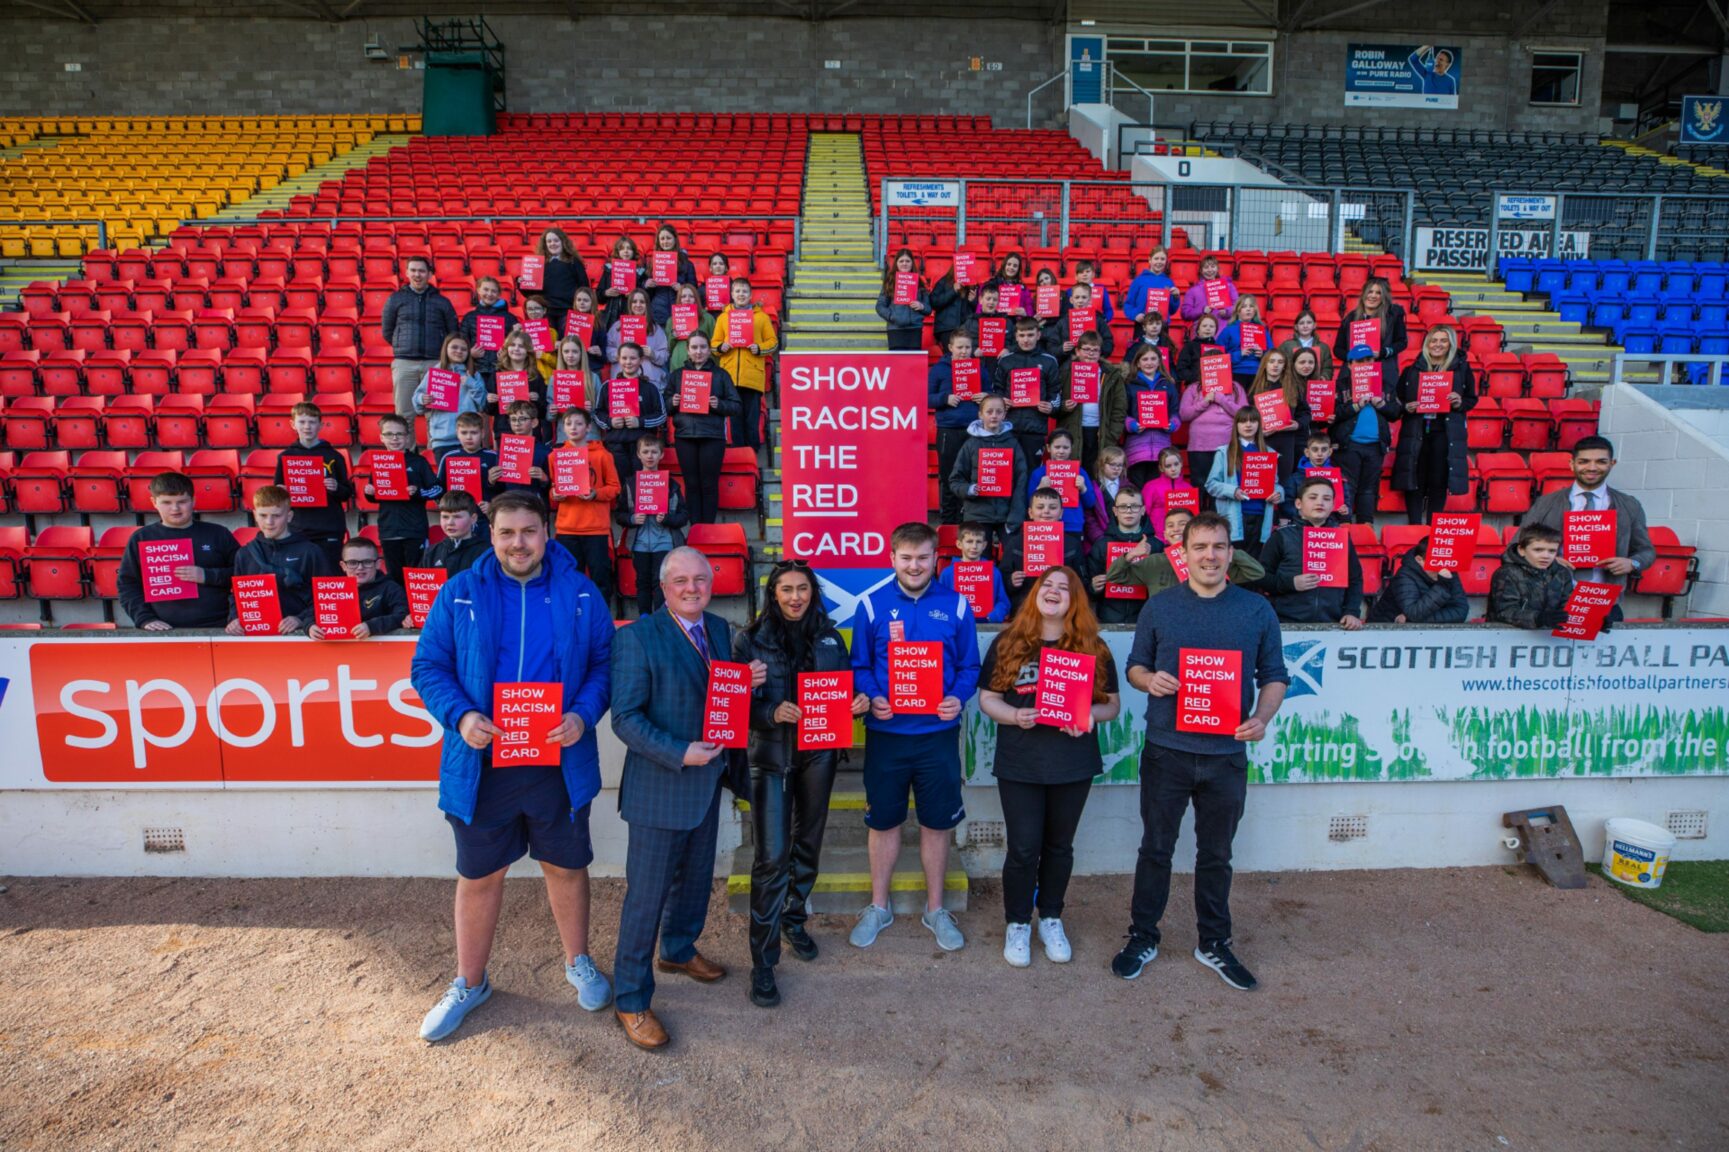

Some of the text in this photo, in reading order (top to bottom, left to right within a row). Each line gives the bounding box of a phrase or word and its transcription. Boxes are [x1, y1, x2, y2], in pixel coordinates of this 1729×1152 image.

[1355, 50, 1385, 59] ROBIN
[1352, 60, 1405, 70] GALLOWAY
[1432, 230, 1523, 250] RESERED
[791, 366, 891, 391] SHOW
[792, 406, 917, 430] RACISM
[792, 445, 857, 469] THE
[793, 484, 858, 509] RED
[1435, 527, 1473, 535] RACISM
[793, 532, 885, 556] CARD
[1308, 541, 1343, 549] RACISM
[1434, 537, 1454, 545] THE
[145, 544, 178, 552] SHOW
[1431, 547, 1452, 556] RED
[146, 553, 188, 562] RACISM
[148, 565, 169, 573] THE
[1307, 561, 1326, 569] RED
[149, 575, 171, 584] RED
[237, 580, 264, 588] SHOW
[317, 581, 344, 589] SHOW
[1578, 585, 1608, 595] SHOW
[150, 586, 181, 595] CARD
[239, 590, 273, 598] RACISM
[241, 600, 258, 608] THE
[1574, 595, 1610, 604] RACISM
[1571, 604, 1590, 613] THE
[242, 611, 261, 620] RED
[319, 614, 338, 622] RED
[245, 623, 269, 631] CARD
[321, 626, 346, 634] CARD
[894, 646, 927, 655] SHOW
[1046, 654, 1080, 667] SHOW
[1186, 655, 1224, 665] SHOW
[1337, 646, 1497, 669] SCOTTISH
[894, 659, 936, 667] RACISM
[714, 667, 741, 678] SHOW
[894, 671, 916, 680] THE
[1044, 666, 1087, 681] RACISM
[1185, 669, 1234, 680] RACISM
[712, 682, 746, 693] RACISM
[804, 678, 838, 687] SHOW
[1044, 679, 1065, 691] THE
[502, 688, 544, 698] SHOW
[894, 683, 917, 693] RED
[1186, 683, 1210, 693] THE
[804, 690, 847, 700] RACISM
[1042, 691, 1064, 704] RED
[711, 696, 729, 707] THE
[895, 698, 926, 706] CARD
[1184, 697, 1210, 709] RED
[501, 702, 554, 712] RACISM
[804, 704, 826, 713] THE
[59, 664, 444, 769] sports
[709, 711, 728, 722] RED
[1040, 707, 1071, 721] CARD
[501, 717, 528, 727] THE
[804, 717, 827, 728] RED
[1183, 714, 1219, 725] CARD
[501, 731, 528, 742] RED
[708, 727, 734, 742] CARD
[803, 732, 835, 742] CARD
[1488, 731, 1592, 759] football
[1674, 731, 1717, 758] the
[500, 748, 539, 758] CARD
